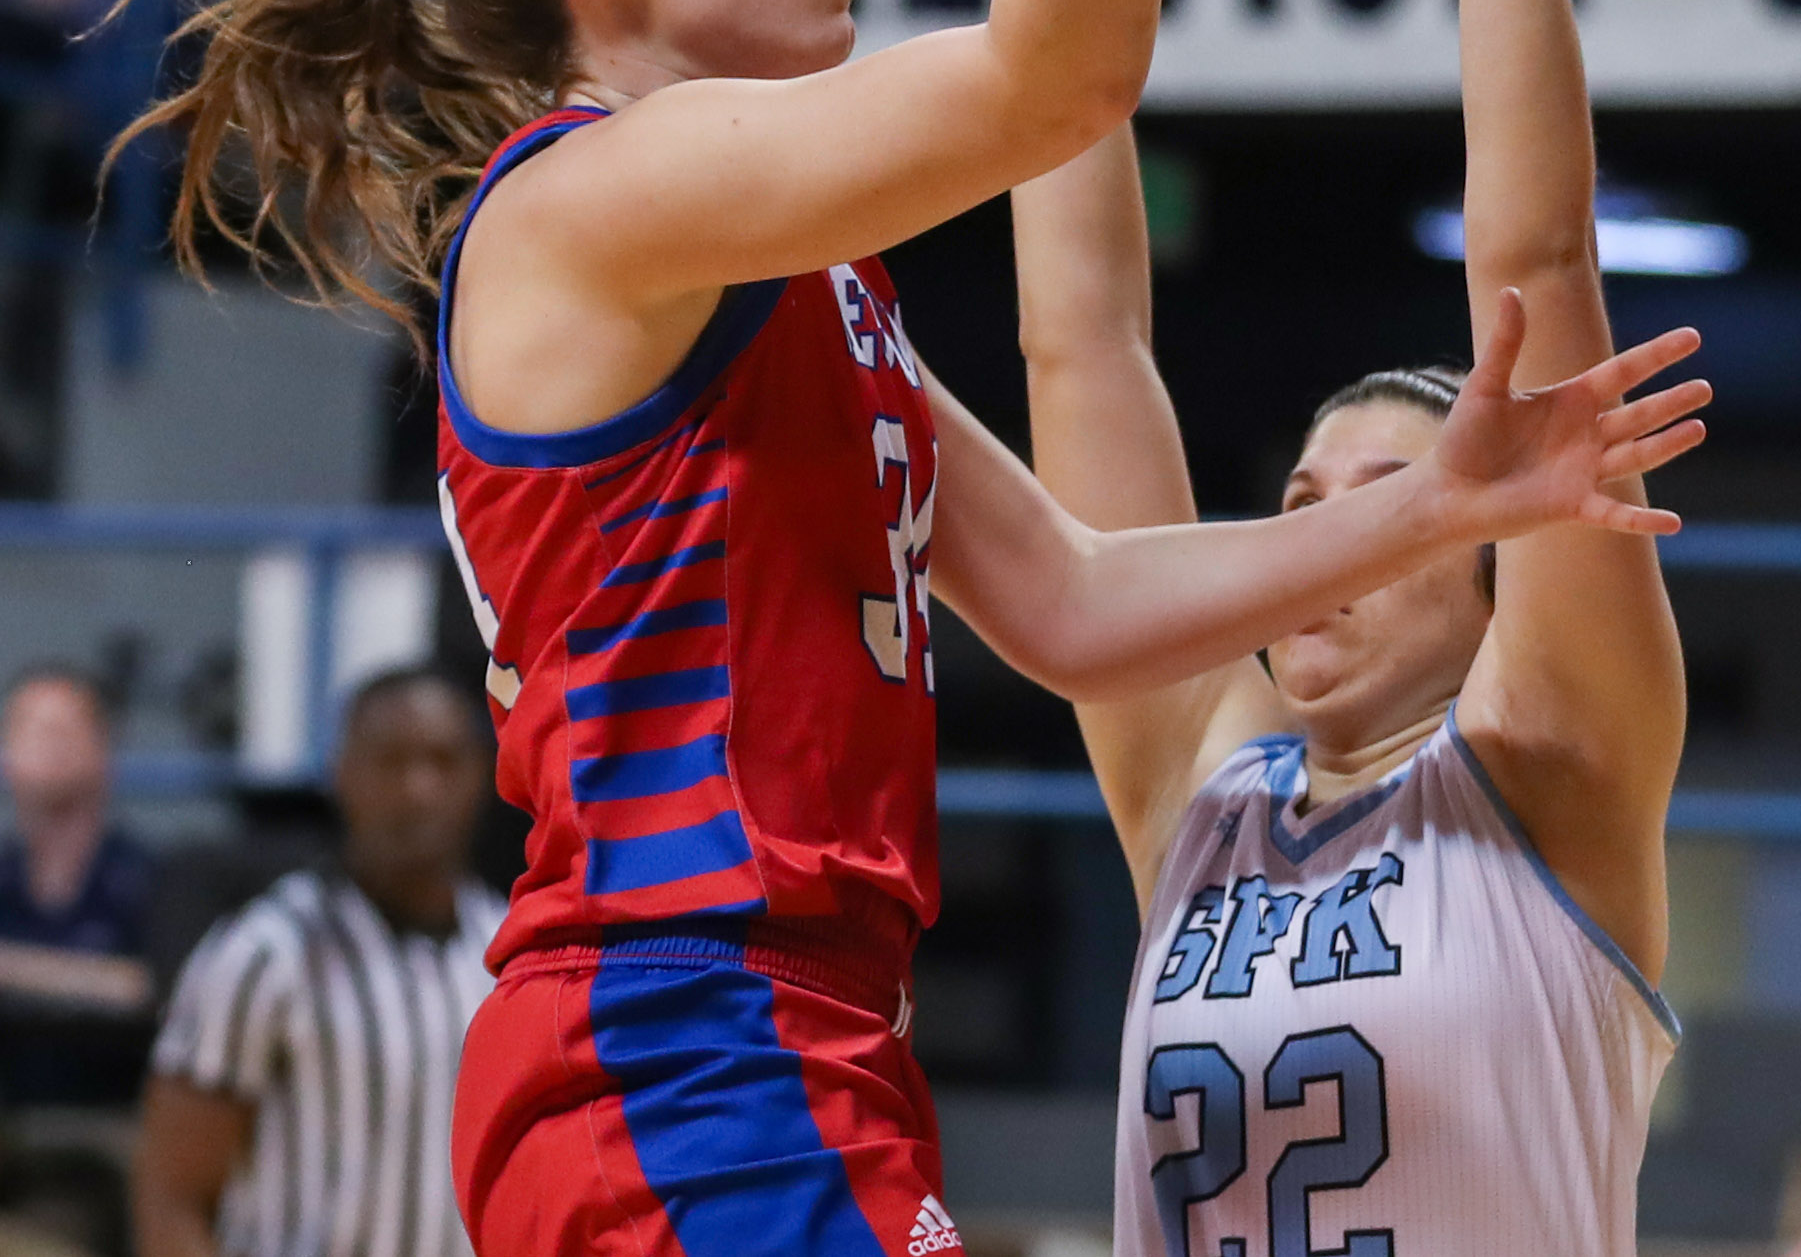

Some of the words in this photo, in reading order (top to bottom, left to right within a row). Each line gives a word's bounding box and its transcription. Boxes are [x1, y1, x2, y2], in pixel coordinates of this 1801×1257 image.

[1152, 851, 1404, 1005] SPK
[1144, 1023, 1394, 1257] 22
[907, 1228, 962, 1257] adid
